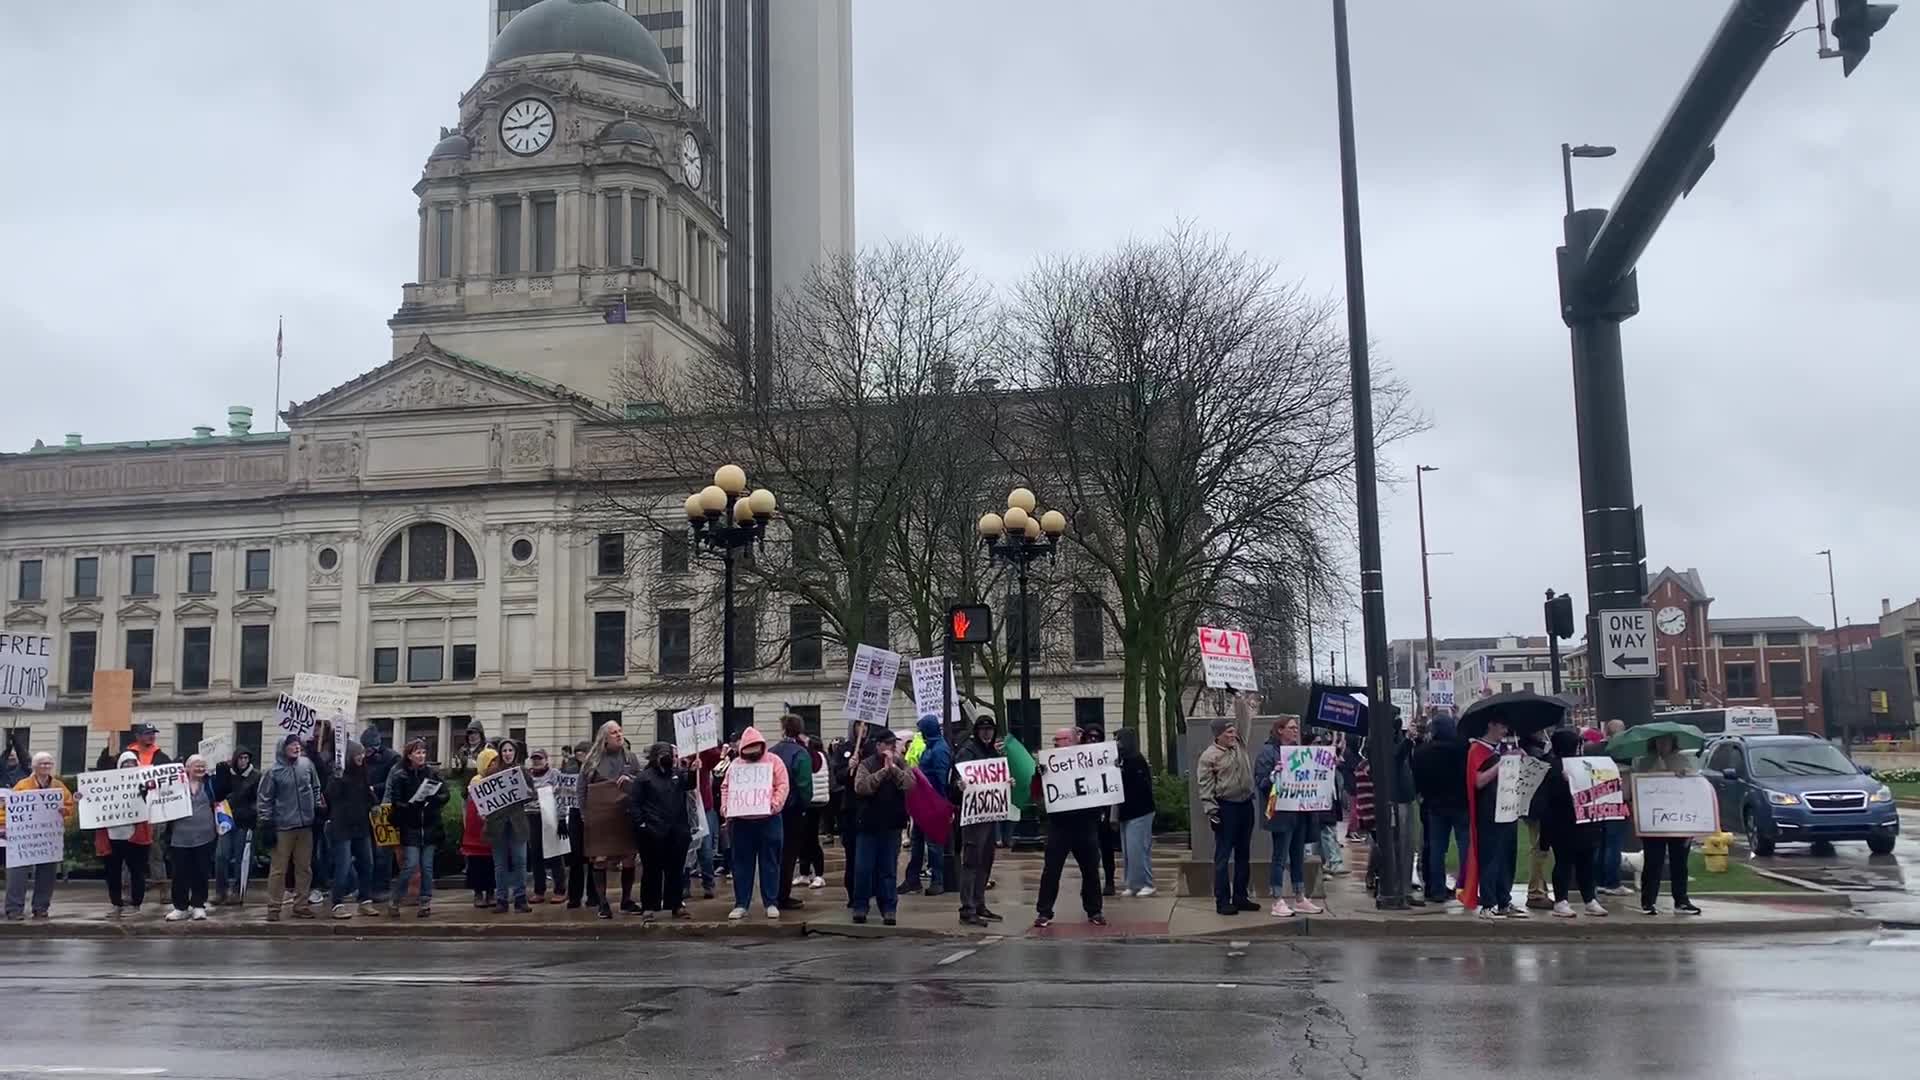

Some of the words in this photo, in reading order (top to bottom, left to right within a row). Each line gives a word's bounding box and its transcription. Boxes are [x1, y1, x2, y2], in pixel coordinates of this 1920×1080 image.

[1610, 616, 1645, 630] ONE
[0, 634, 51, 656] FREE
[1609, 633, 1647, 648] WAY
[279, 694, 316, 728] HANDS
[677, 707, 713, 728] NEVER
[1048, 754, 1074, 773] Get
[1077, 752, 1093, 768] Rid
[1097, 750, 1108, 765] of
[81, 777, 107, 785] SAVE
[121, 773, 140, 781] THE
[142, 766, 185, 780] HANDS
[965, 762, 1006, 784] SMASH
[1296, 769, 1310, 781] FOR
[1314, 769, 1328, 780] THE
[90, 783, 137, 793] COUNTRY
[475, 776, 506, 798] HOPE
[10, 794, 35, 804] DID
[40, 793, 62, 801] YOU
[87, 795, 114, 803] SAVE
[486, 789, 520, 811] ALIVE
[964, 789, 1008, 817] FASCISM
[8, 804, 37, 813] VOTE
[102, 802, 131, 811] CIVIL
[96, 811, 139, 822] SERVICE
[1652, 808, 1697, 826] FACIST
